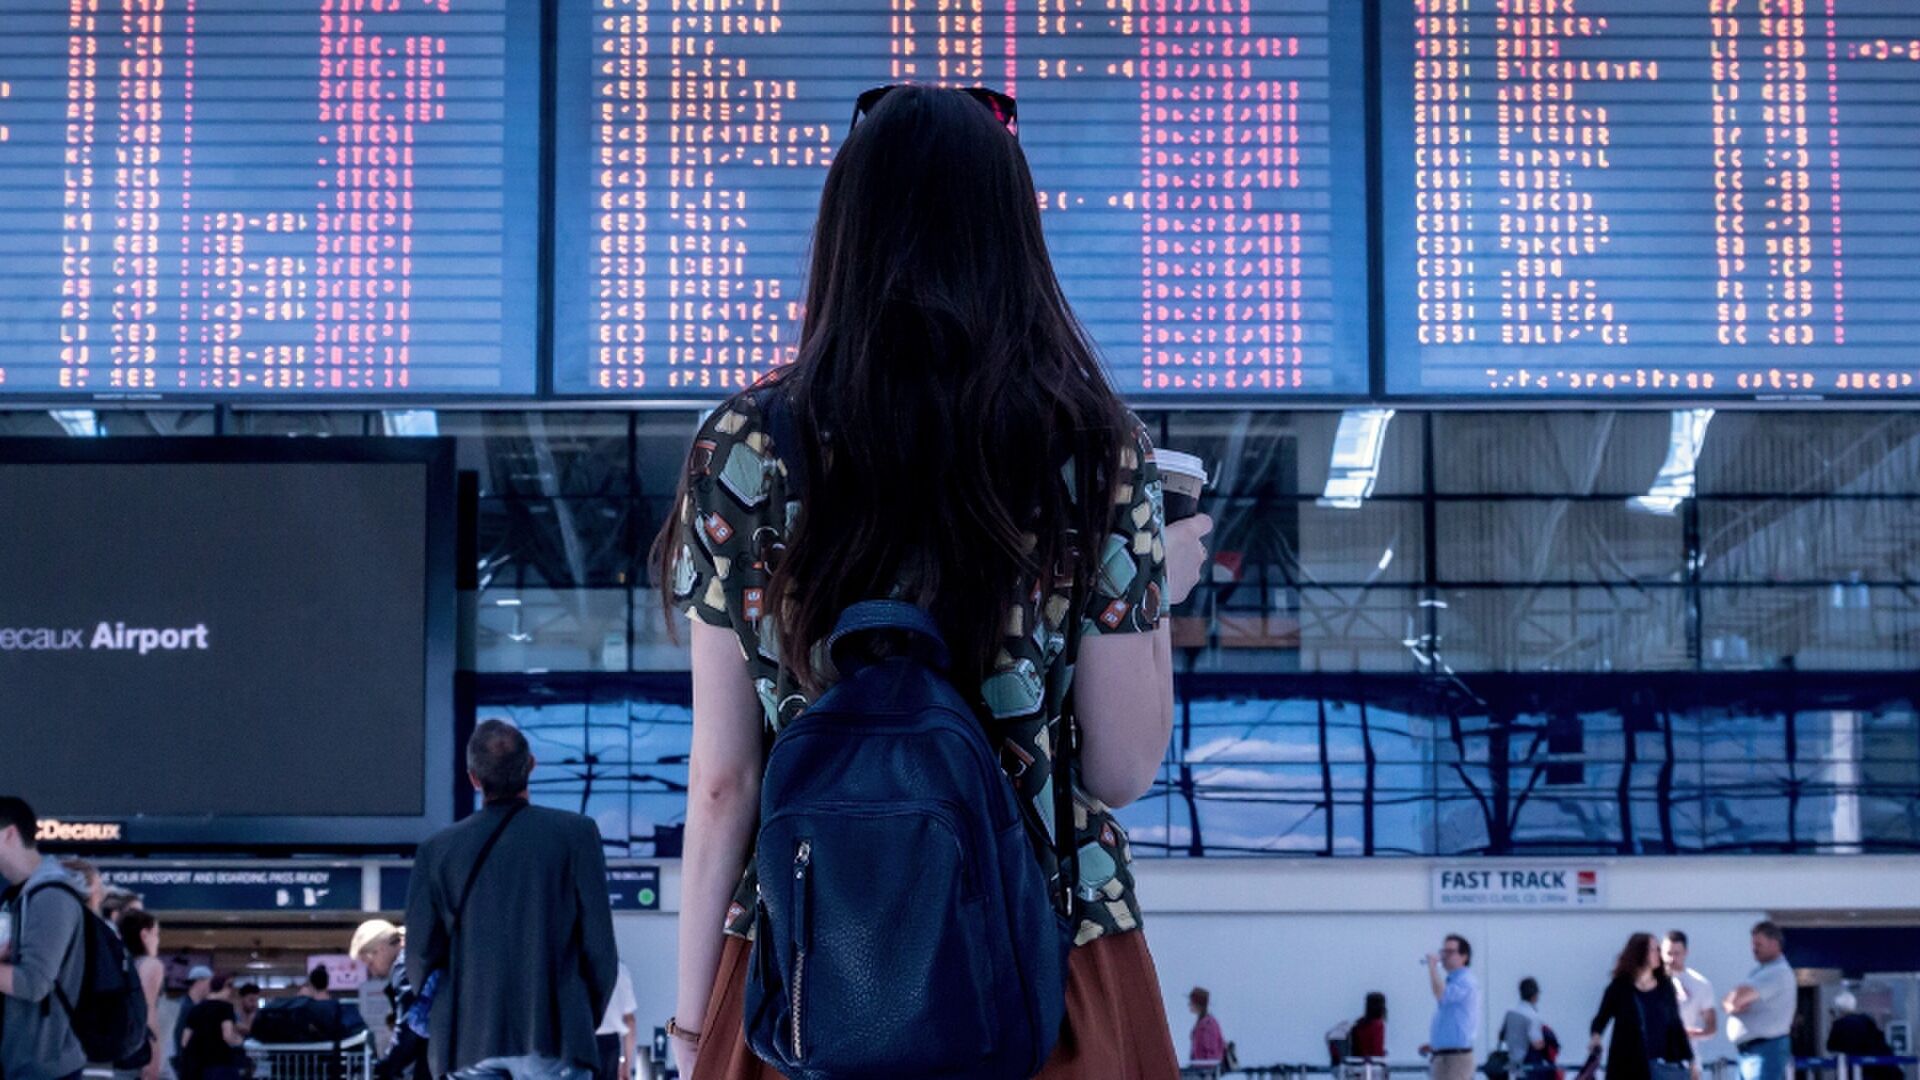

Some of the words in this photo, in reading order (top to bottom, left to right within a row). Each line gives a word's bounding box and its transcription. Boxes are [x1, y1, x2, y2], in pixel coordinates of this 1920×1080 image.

[90, 621, 209, 654] Airport
[113, 871, 139, 884] YOUR
[141, 871, 192, 884] PASSPORT
[193, 871, 215, 884] AND
[216, 871, 268, 884] BOARDING
[269, 871, 294, 884] PASS
[295, 871, 330, 884] READY
[1441, 870, 1491, 889] FAST
[1500, 870, 1566, 889] TRACK
